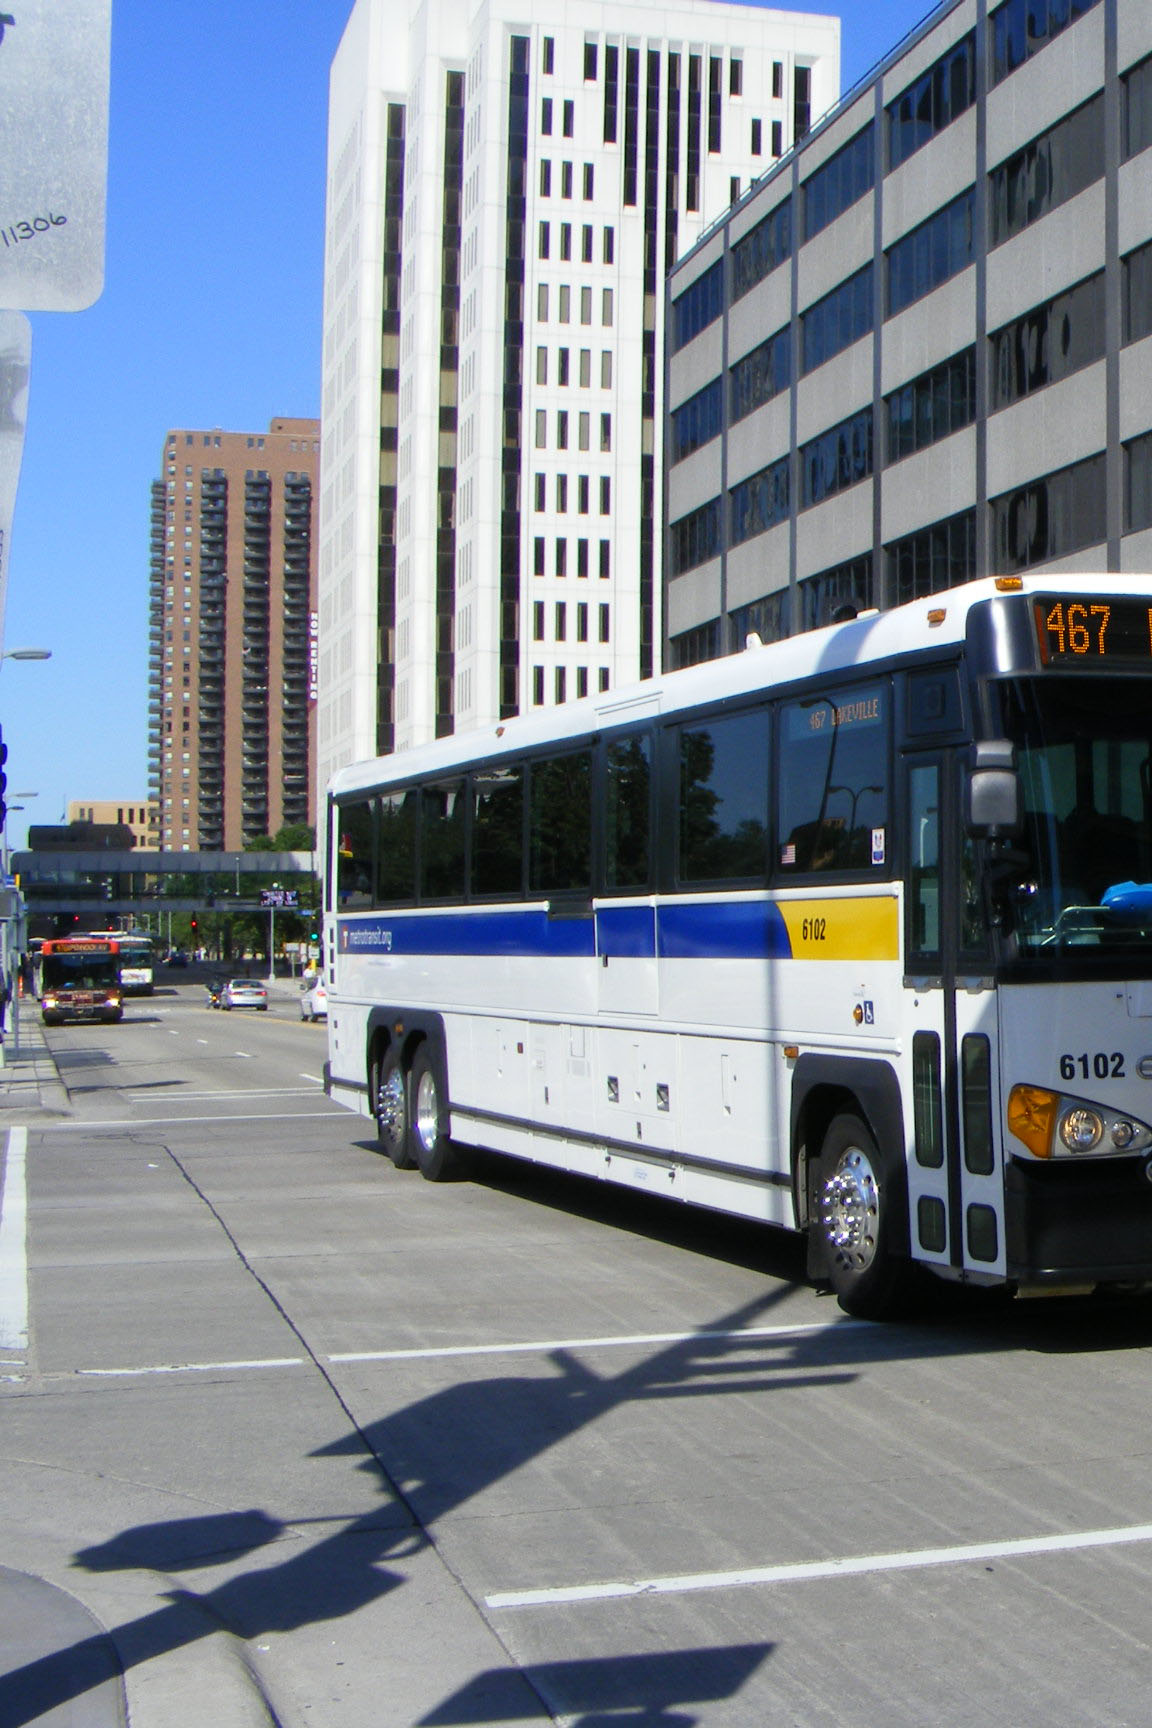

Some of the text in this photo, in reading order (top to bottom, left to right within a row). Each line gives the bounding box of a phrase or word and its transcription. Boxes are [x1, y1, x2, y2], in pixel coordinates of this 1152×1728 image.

[1, 211, 68, 248] 11306
[1047, 602, 1111, 655] 467
[832, 698, 879, 727] LAKEVILLE
[350, 926, 392, 951] metrotransit.org
[802, 918, 827, 942] 6102
[1060, 1052, 1126, 1080] 6102
